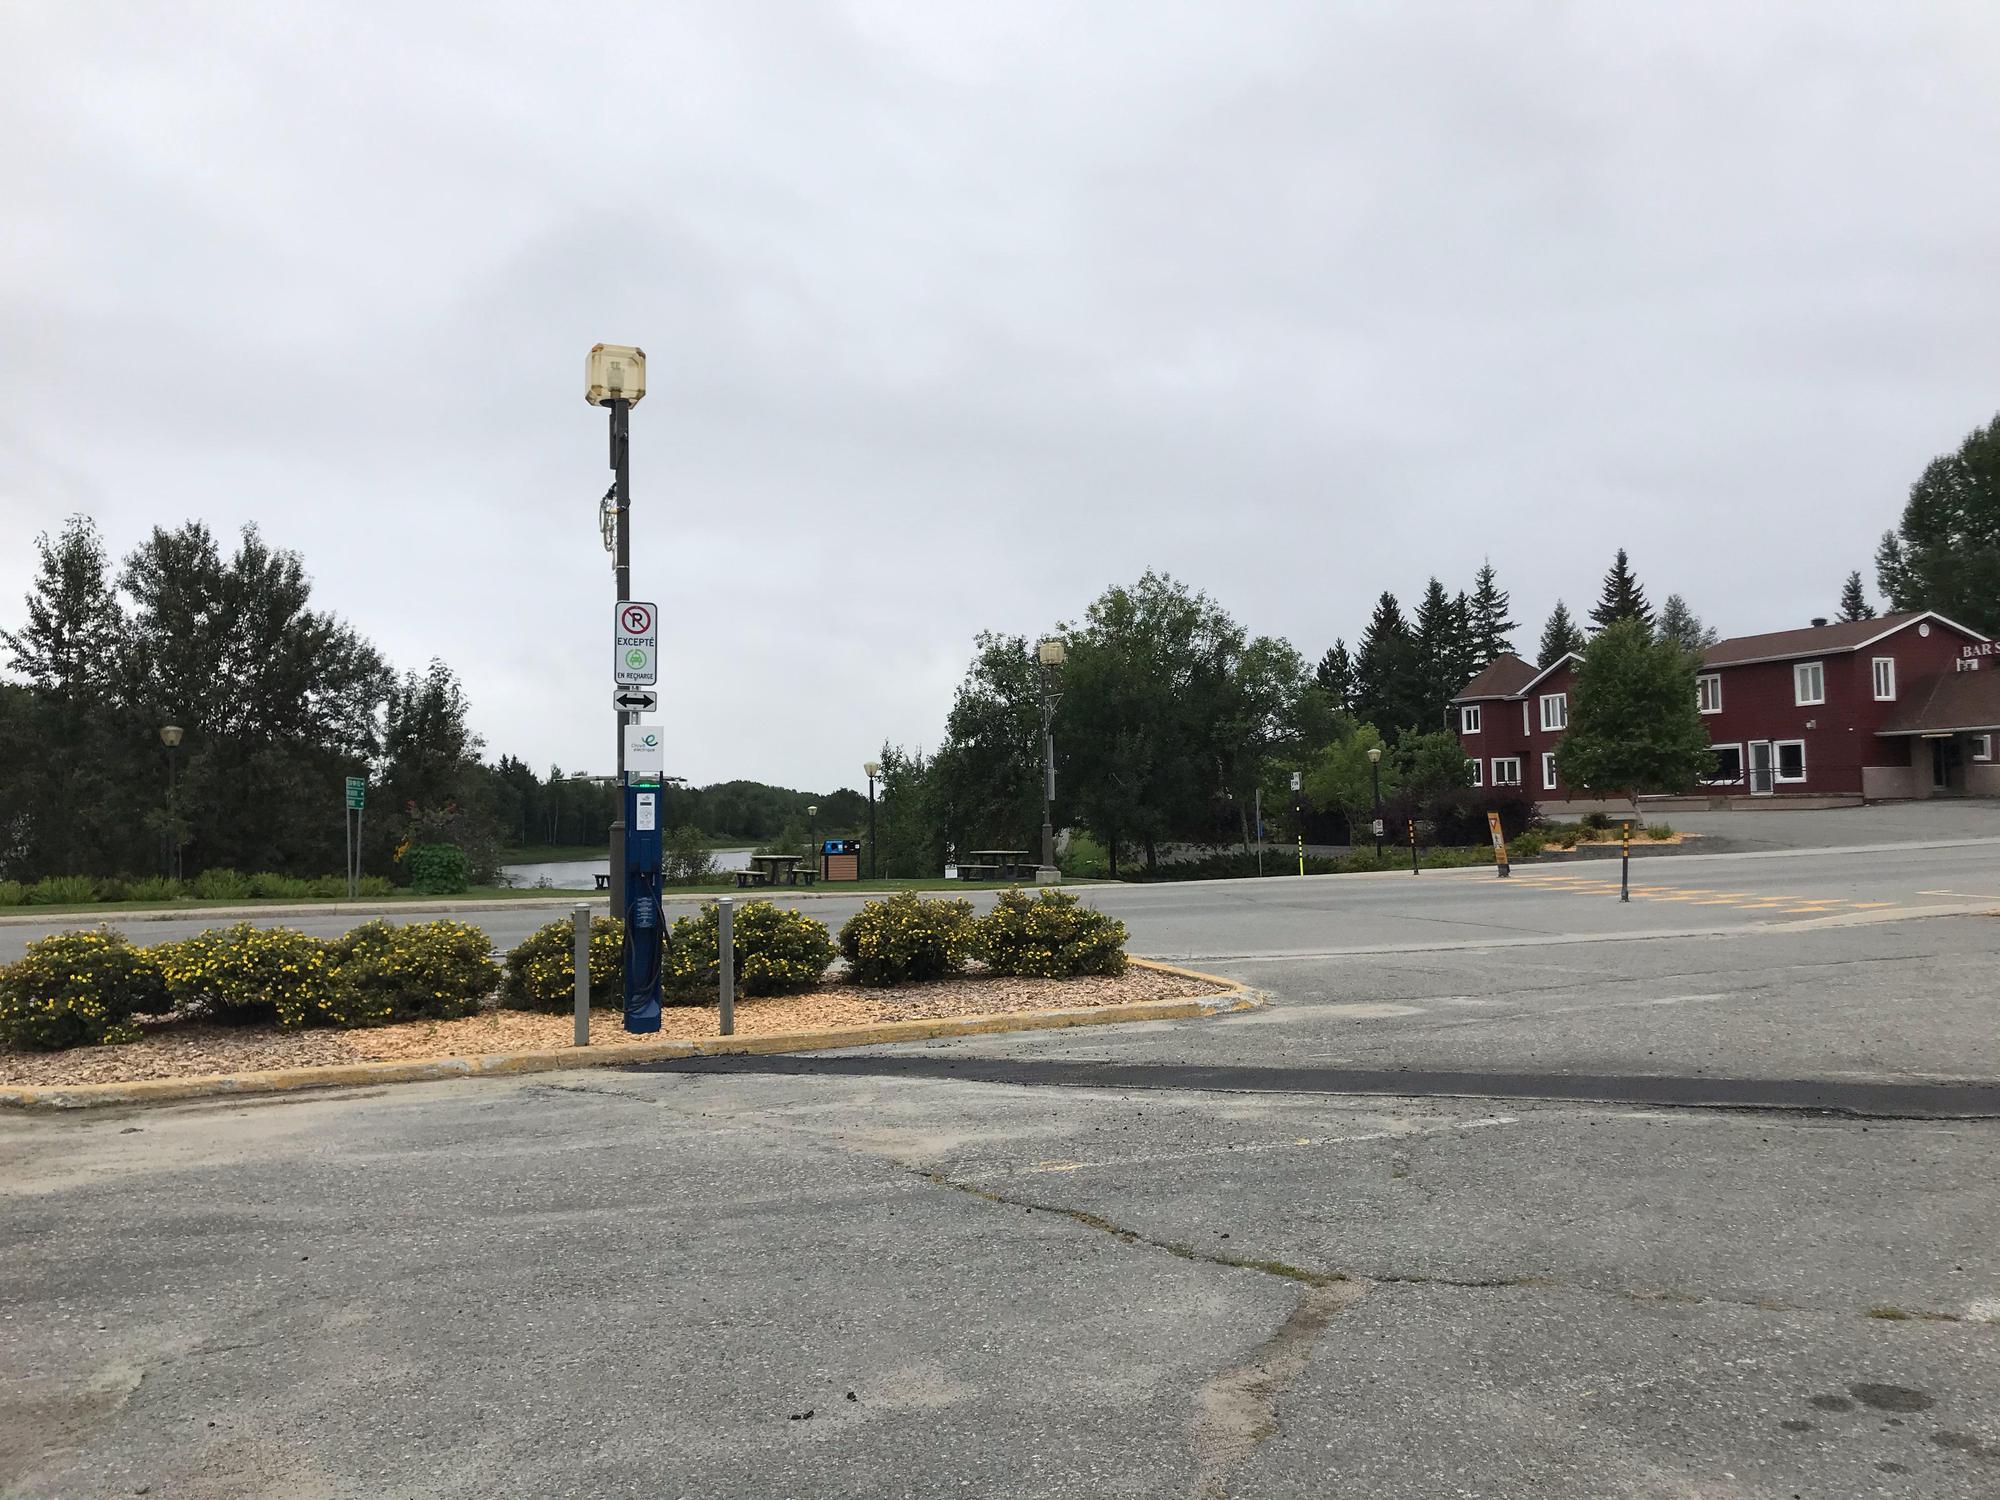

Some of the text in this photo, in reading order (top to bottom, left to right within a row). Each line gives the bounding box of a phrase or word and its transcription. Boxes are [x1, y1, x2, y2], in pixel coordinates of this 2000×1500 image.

[617, 637, 655, 647] EXCEPTÉ
[1963, 643, 1992, 658] BAR
[626, 672, 654, 680] RECHARGE
